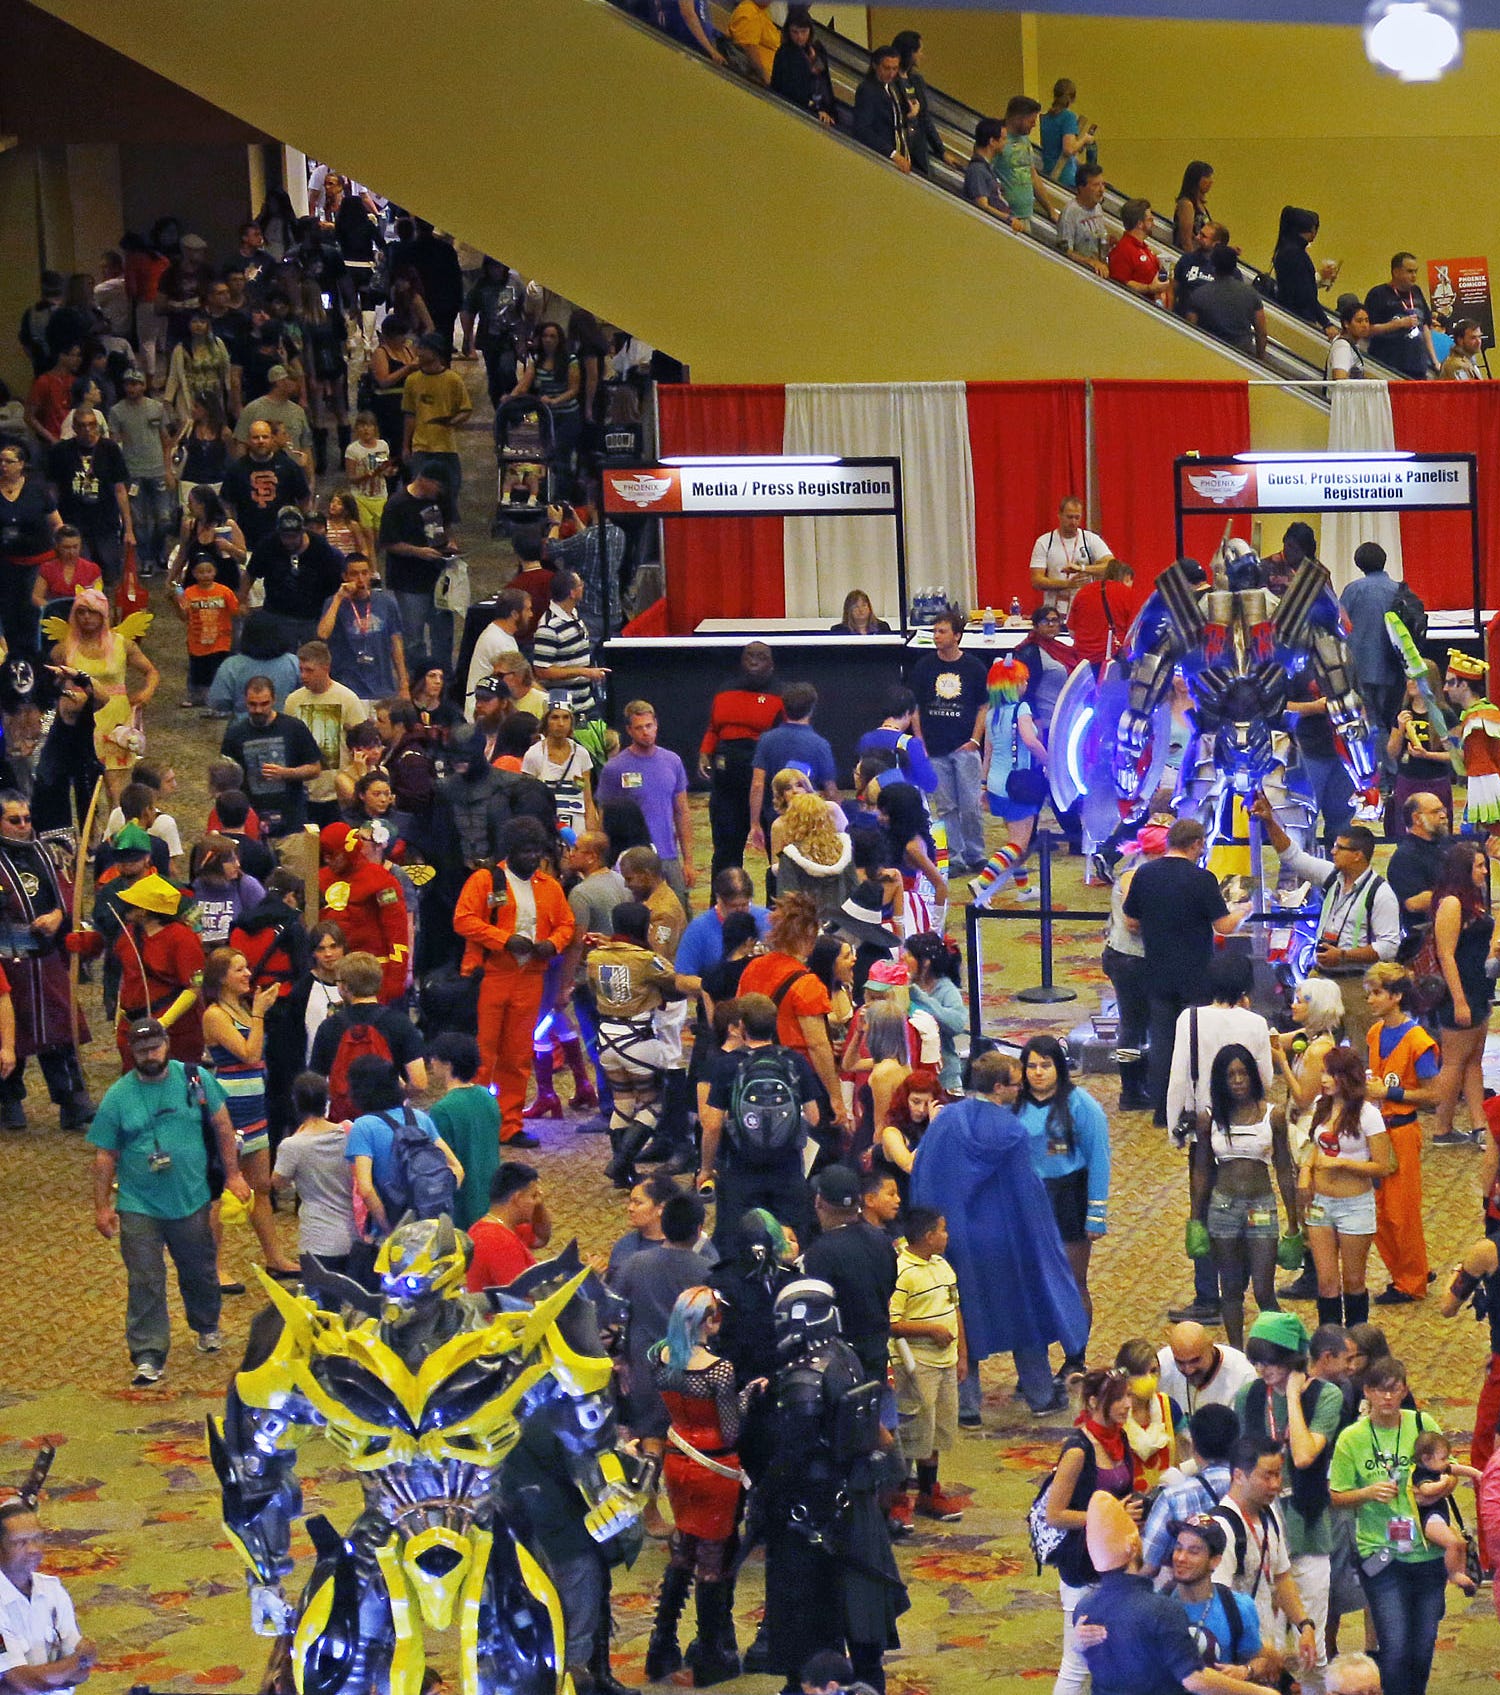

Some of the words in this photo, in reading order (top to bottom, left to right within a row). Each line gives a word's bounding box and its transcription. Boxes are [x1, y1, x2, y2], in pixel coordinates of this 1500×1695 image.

[1200, 479, 1236, 487] PHOENIX
[1267, 473, 1308, 486] Guest,
[1310, 470, 1392, 485] Professional
[1394, 471, 1403, 483] &
[1406, 469, 1460, 483] Panelist
[692, 482, 738, 497] Media
[741, 481, 748, 497] /
[752, 480, 794, 496] Press
[798, 478, 891, 497] Registration
[1323, 487, 1404, 501] Registration
